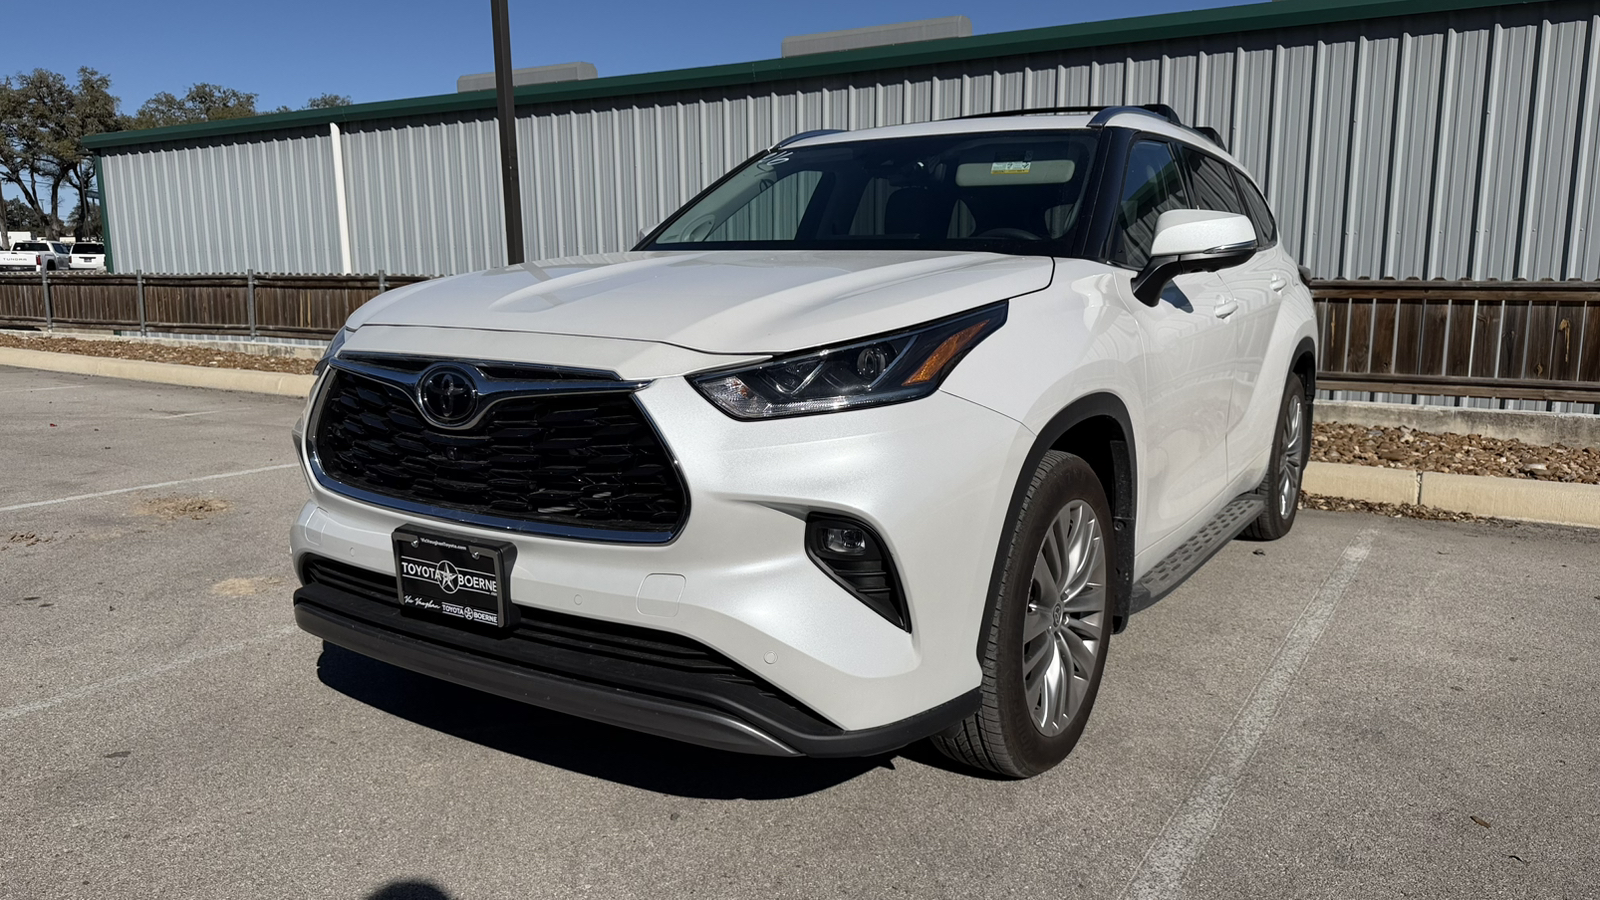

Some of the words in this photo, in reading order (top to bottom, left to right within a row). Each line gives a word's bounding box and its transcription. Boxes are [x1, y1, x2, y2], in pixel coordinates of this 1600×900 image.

[401, 562, 442, 581] TOYOTA
[459, 574, 498, 592] BOERNE
[441, 604, 464, 615] TOYOTA
[473, 611, 498, 623] BOERNE
